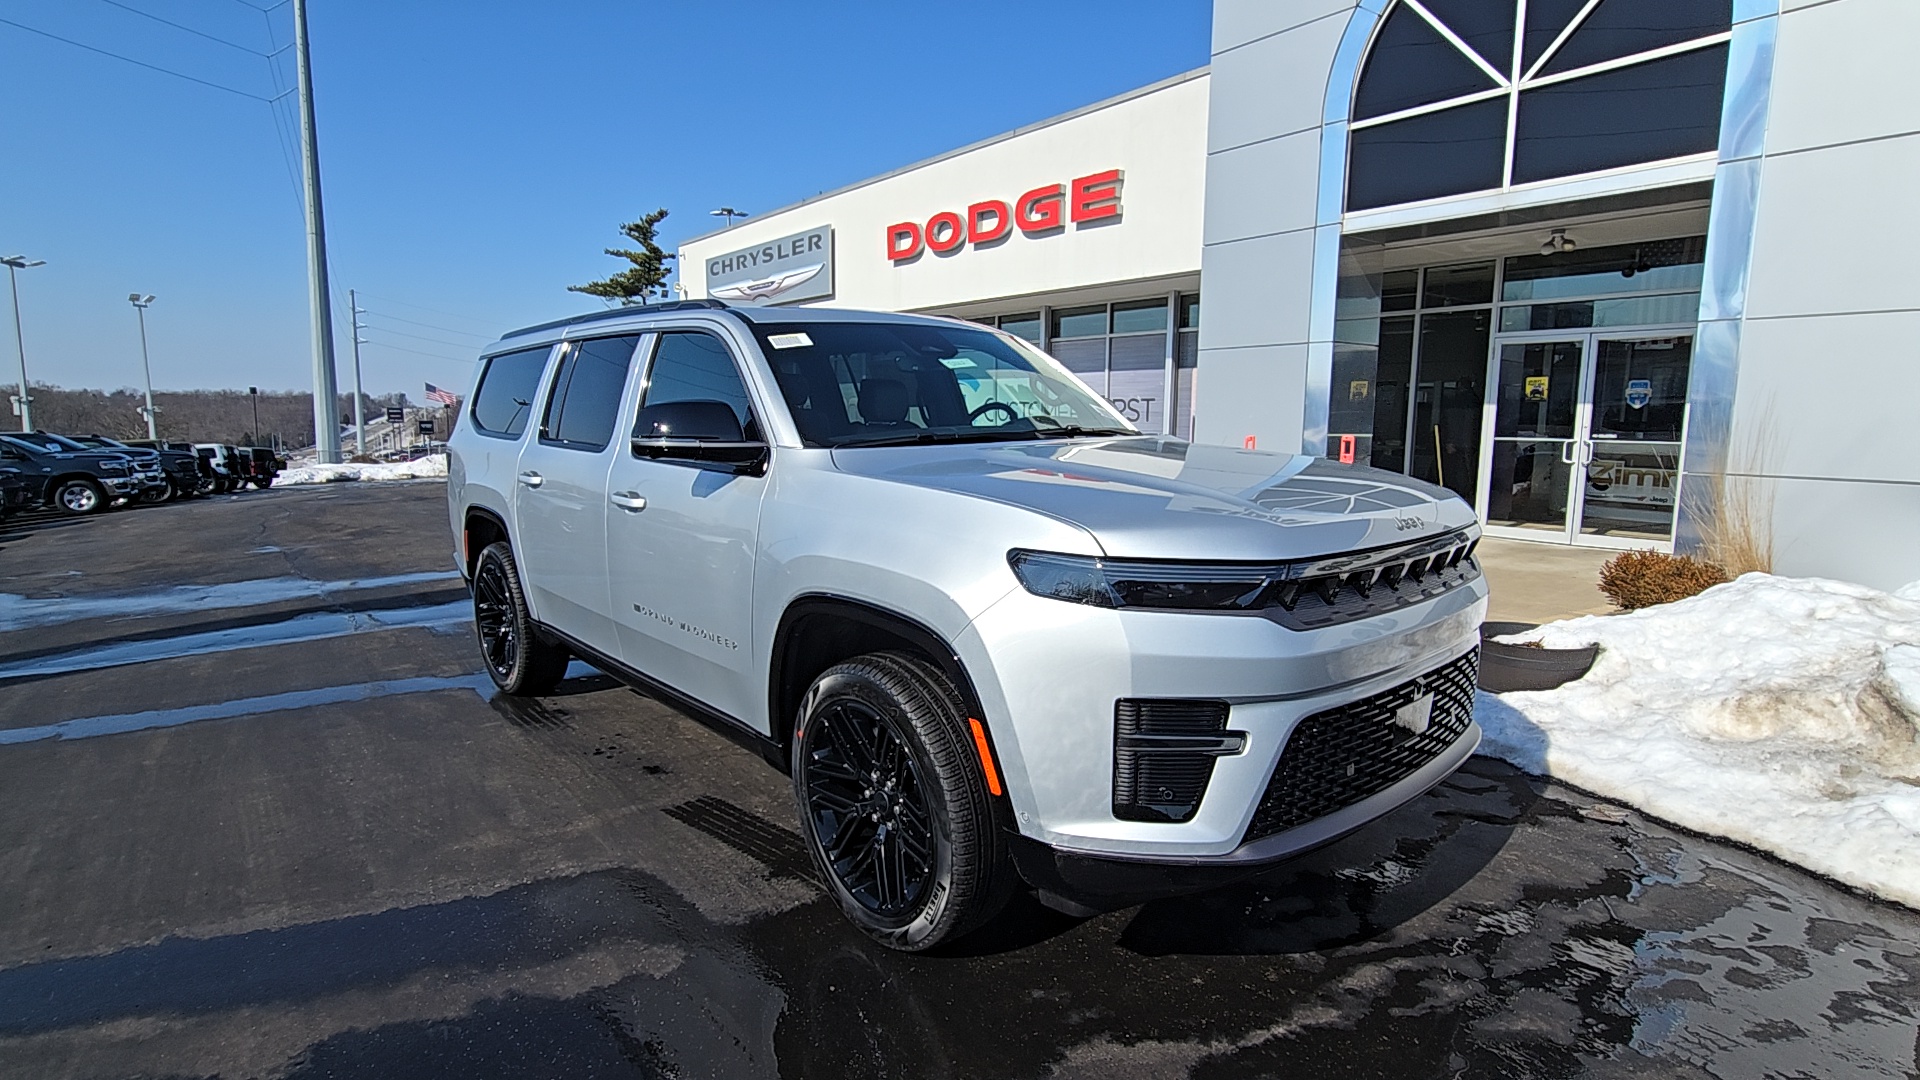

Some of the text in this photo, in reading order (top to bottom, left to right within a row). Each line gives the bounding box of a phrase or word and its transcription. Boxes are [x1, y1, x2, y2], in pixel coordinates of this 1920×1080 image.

[887, 169, 1124, 262] DODGE
[710, 233, 822, 276] CHRYSLER
[1394, 516, 1424, 531] Jeep
[679, 621, 738, 650] WAGONEER
[924, 880, 947, 926] PIRELLI
